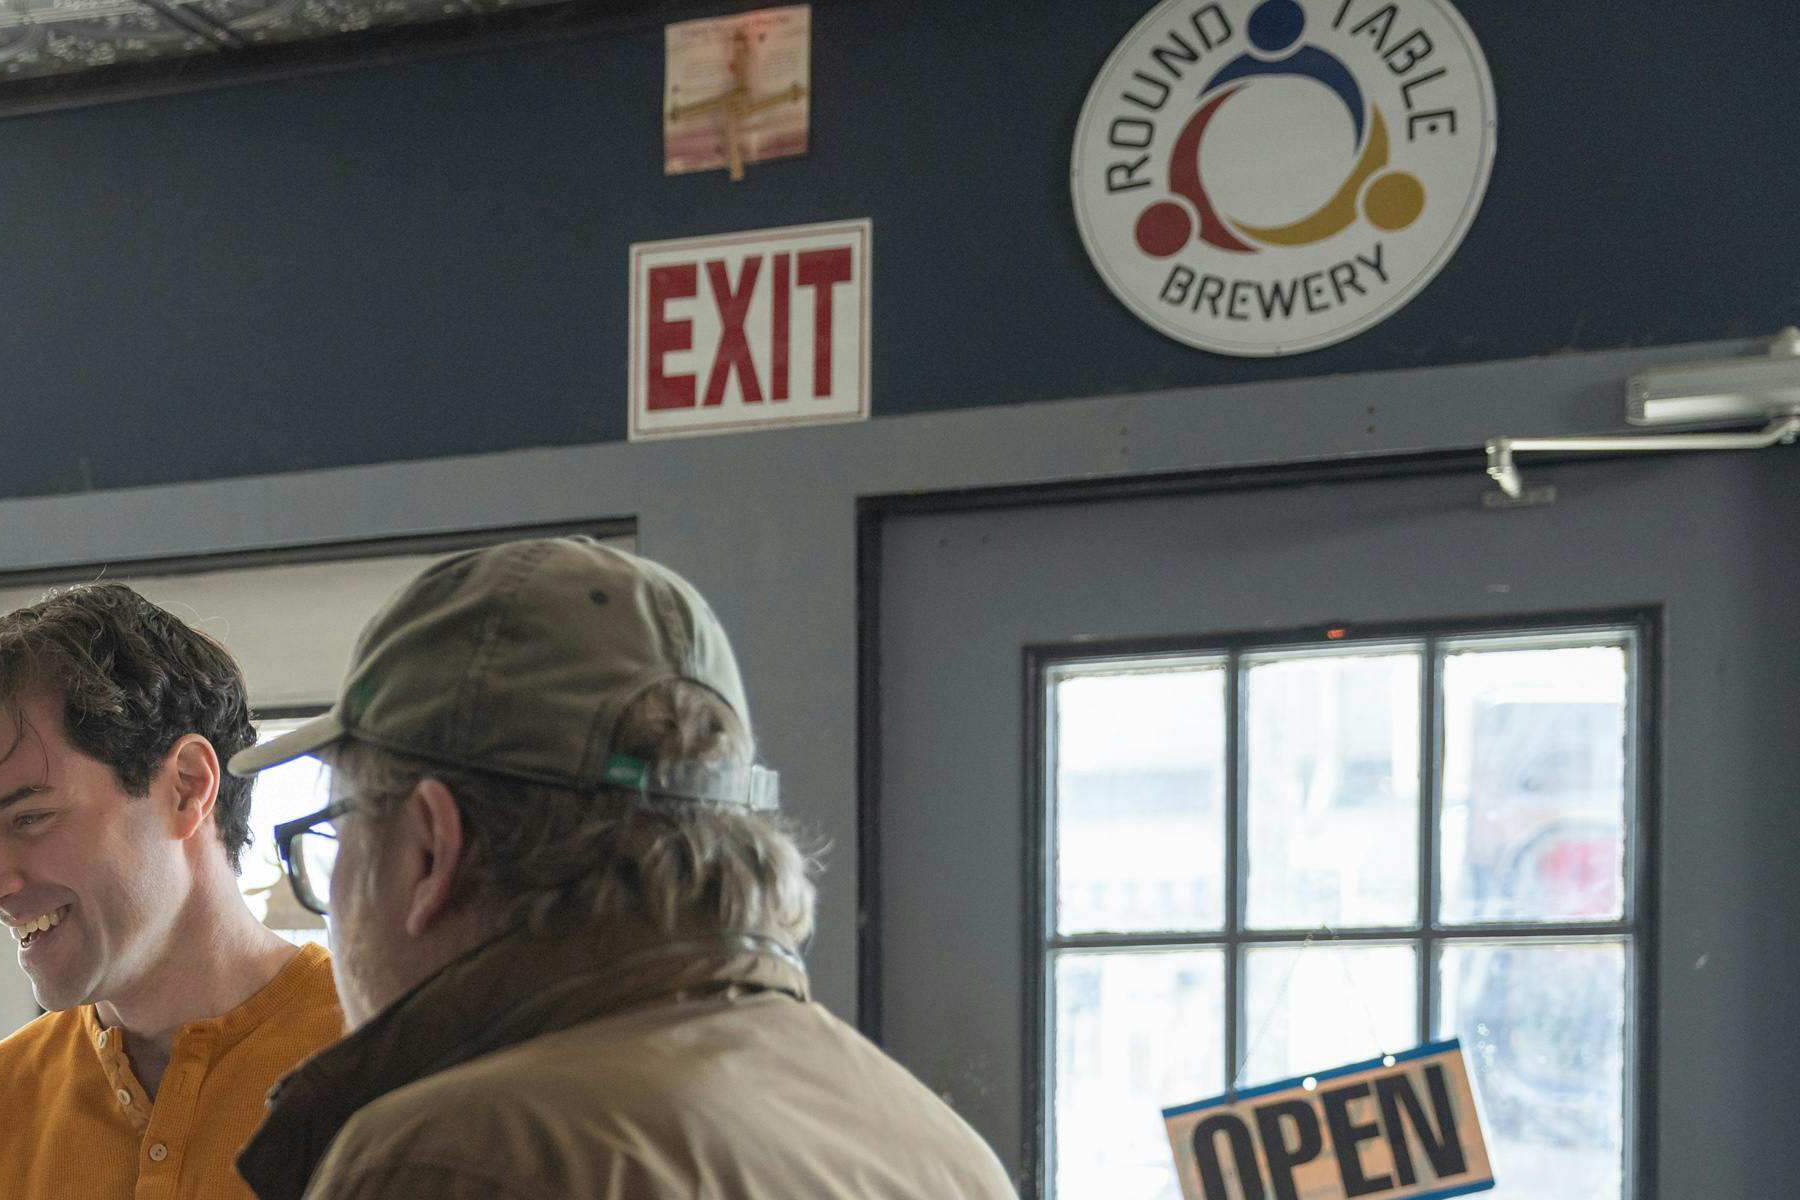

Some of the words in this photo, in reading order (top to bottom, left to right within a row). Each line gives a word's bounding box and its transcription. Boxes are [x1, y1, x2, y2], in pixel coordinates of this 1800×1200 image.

[1106, 4, 1233, 193] ROUND
[646, 247, 852, 412] EXIT
[1159, 241, 1389, 321] BREWERY
